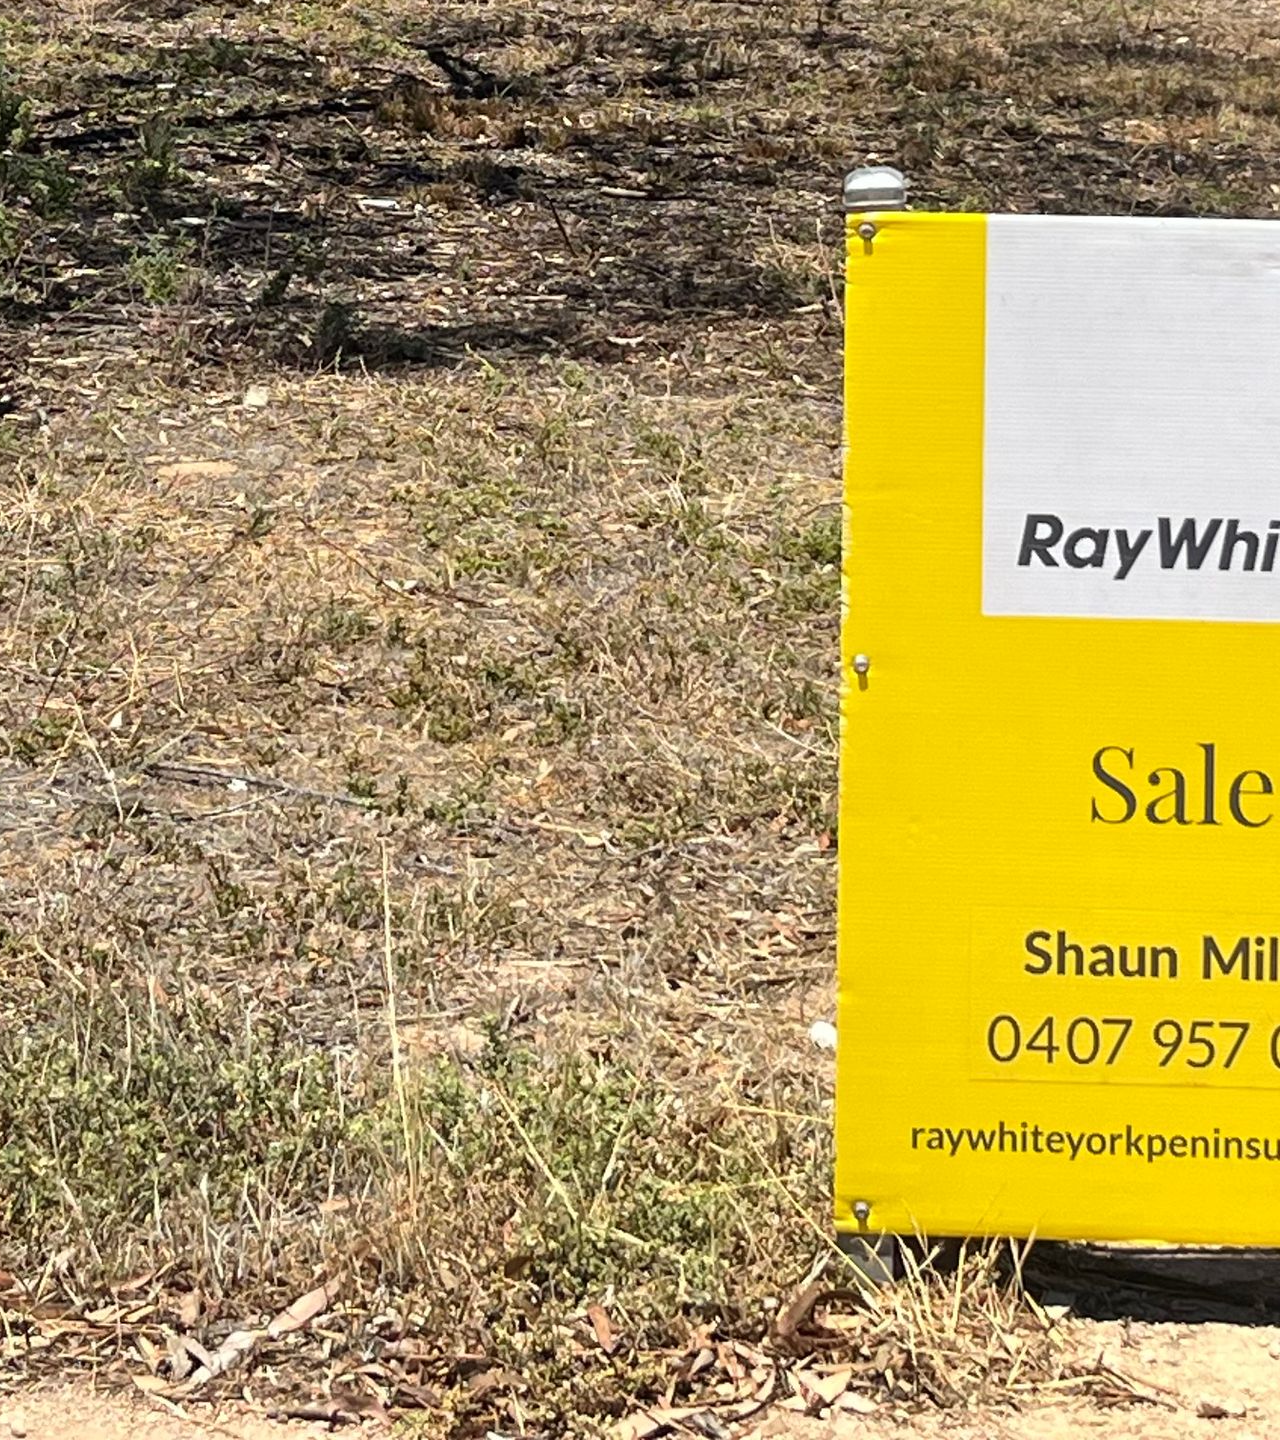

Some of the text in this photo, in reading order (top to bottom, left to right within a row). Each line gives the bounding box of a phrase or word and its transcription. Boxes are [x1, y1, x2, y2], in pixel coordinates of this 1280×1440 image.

[1091, 743, 1273, 828] Sale
[1024, 930, 1178, 979] Shaun
[987, 1015, 1133, 1065] 0407
[1153, 1019, 1250, 1069] 957
